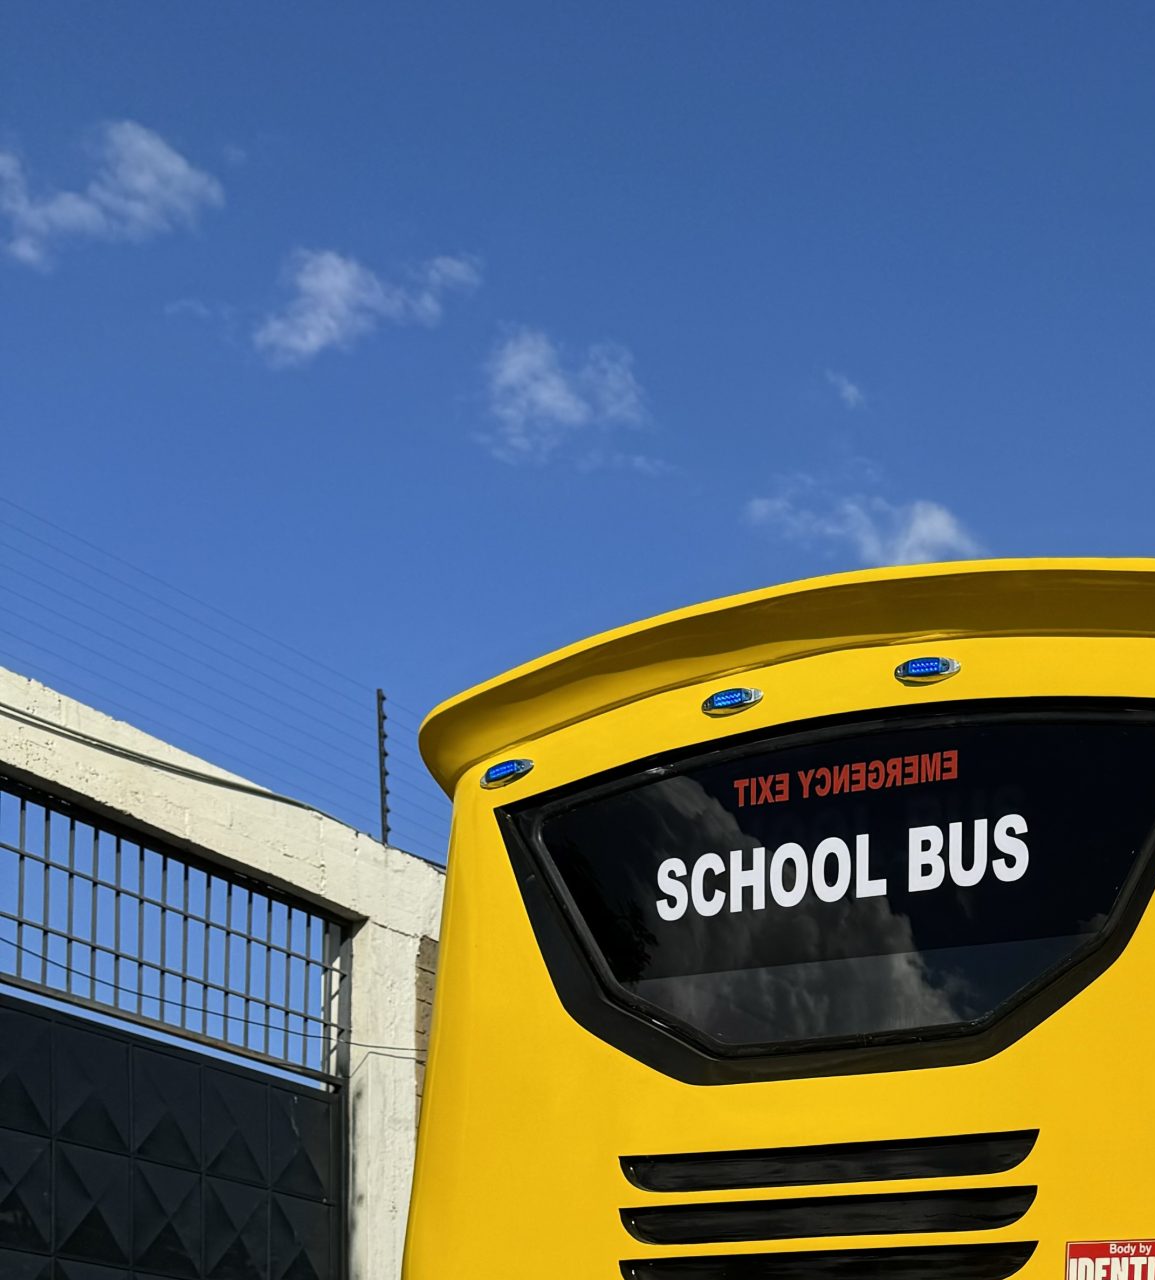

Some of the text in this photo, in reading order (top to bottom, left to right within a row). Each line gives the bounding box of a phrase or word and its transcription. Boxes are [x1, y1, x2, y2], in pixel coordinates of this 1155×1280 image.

[655, 813, 1030, 922] SCHOOL BUS
[1109, 1242, 1153, 1256] Body by
